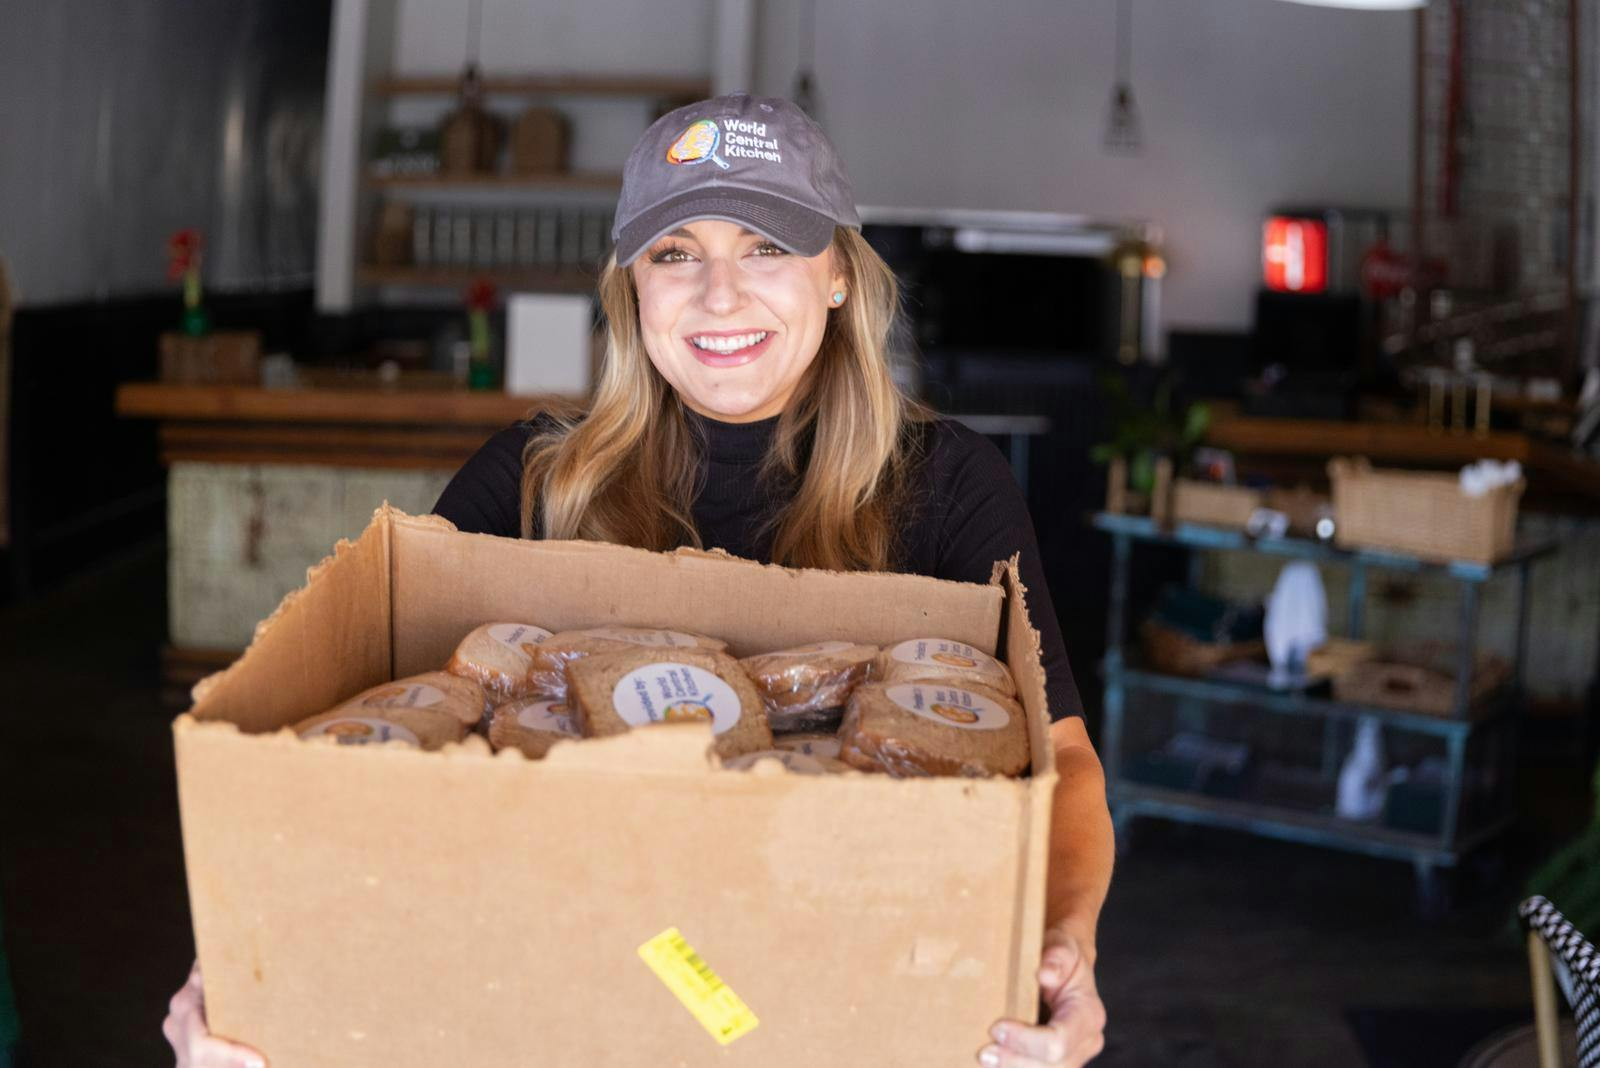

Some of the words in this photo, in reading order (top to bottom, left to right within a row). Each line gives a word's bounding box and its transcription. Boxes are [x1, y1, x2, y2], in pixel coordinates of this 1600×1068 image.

[723, 119, 766, 137] World
[725, 132, 778, 150] Central
[725, 144, 781, 163] Kitchen
